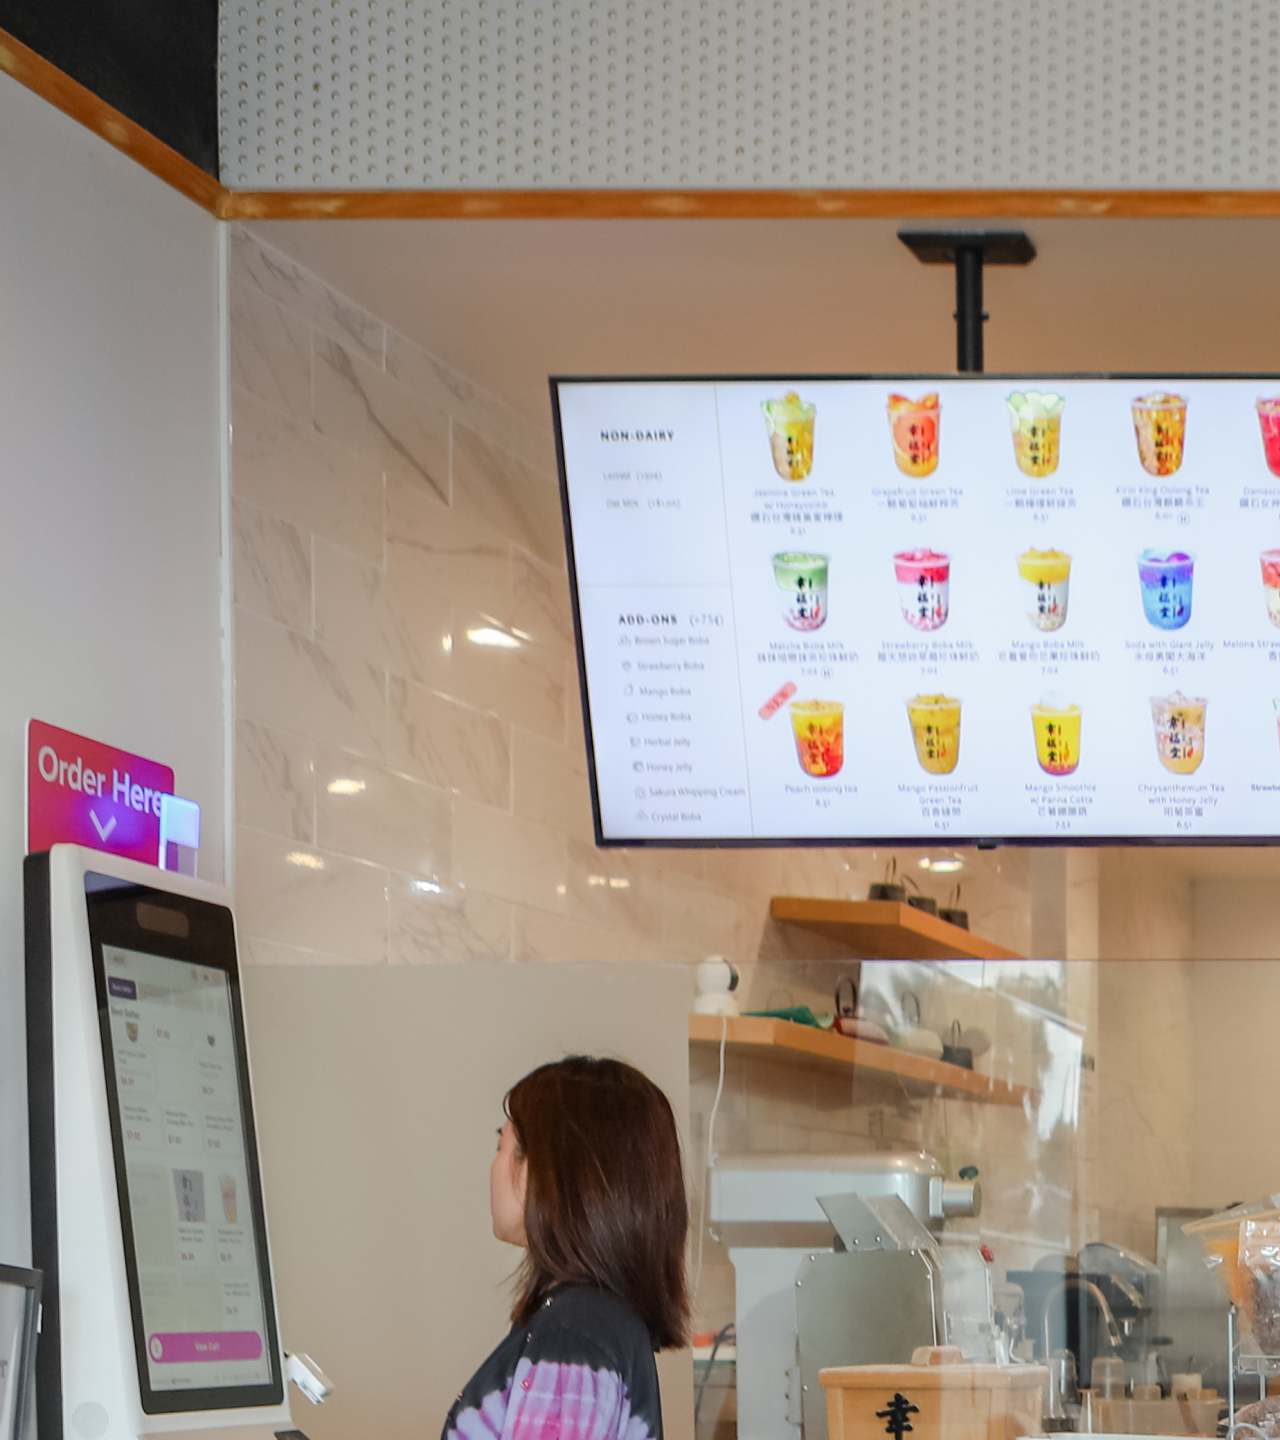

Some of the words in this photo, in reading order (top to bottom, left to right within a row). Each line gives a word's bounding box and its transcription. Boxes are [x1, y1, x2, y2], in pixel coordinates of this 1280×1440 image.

[600, 430, 675, 442] NON-DAIRY
[618, 614, 678, 625] ADD-ONS
[38, 746, 106, 798] Order
[112, 769, 163, 817] Here
